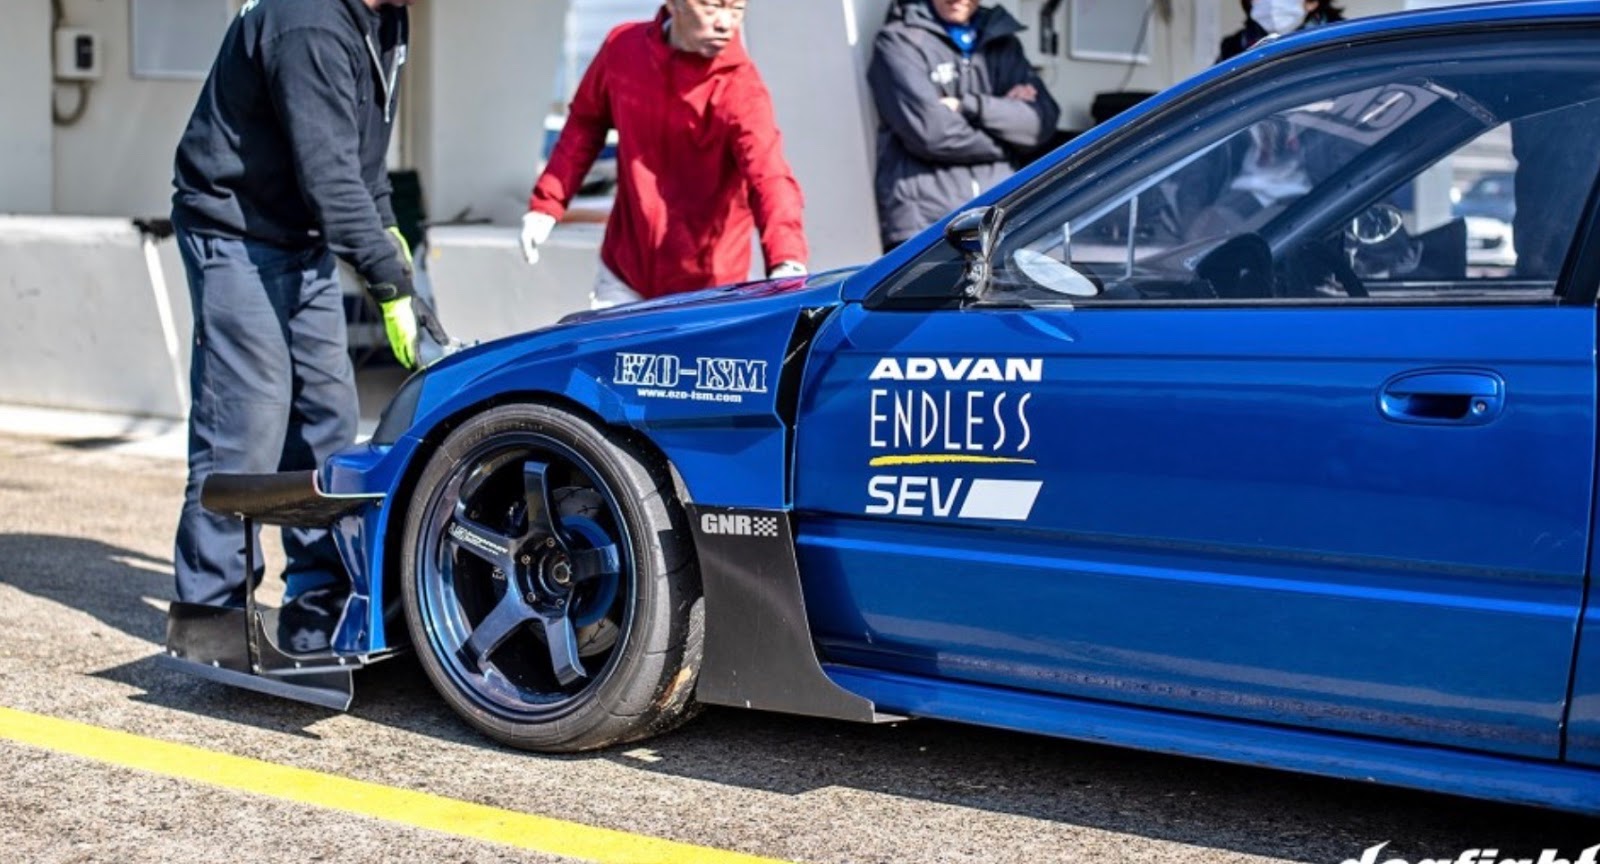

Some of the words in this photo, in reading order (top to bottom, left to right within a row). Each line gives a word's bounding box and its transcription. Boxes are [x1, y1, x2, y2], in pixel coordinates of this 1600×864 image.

[613, 352, 767, 393] EZO-ISM
[868, 357, 1043, 382] ADVAN
[637, 388, 742, 403] www.ezo-ism.com
[870, 389, 1031, 451] ENDLESS
[865, 475, 964, 517] SEV
[701, 513, 752, 535] GNR
